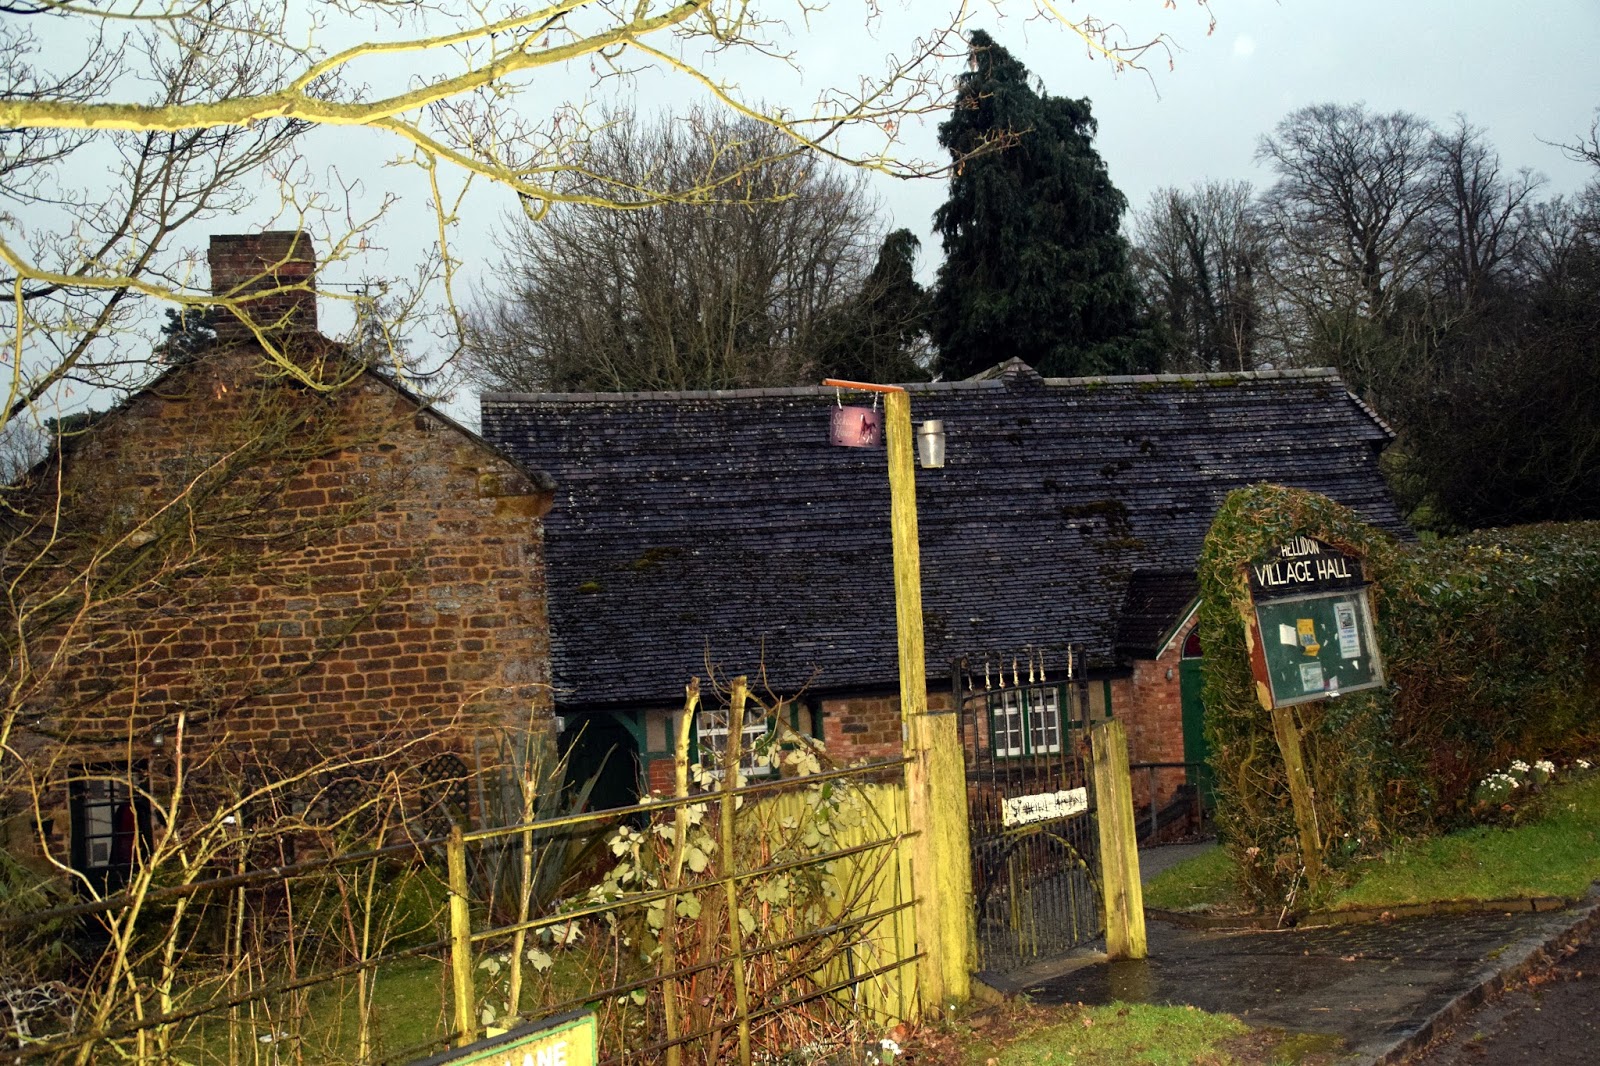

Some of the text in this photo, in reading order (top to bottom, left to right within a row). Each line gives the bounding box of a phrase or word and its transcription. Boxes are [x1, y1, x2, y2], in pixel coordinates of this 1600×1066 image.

[1280, 536, 1320, 557] HELLIDON
[1254, 558, 1352, 586] VILLAGE HALL
[504, 1041, 568, 1066] ANE
